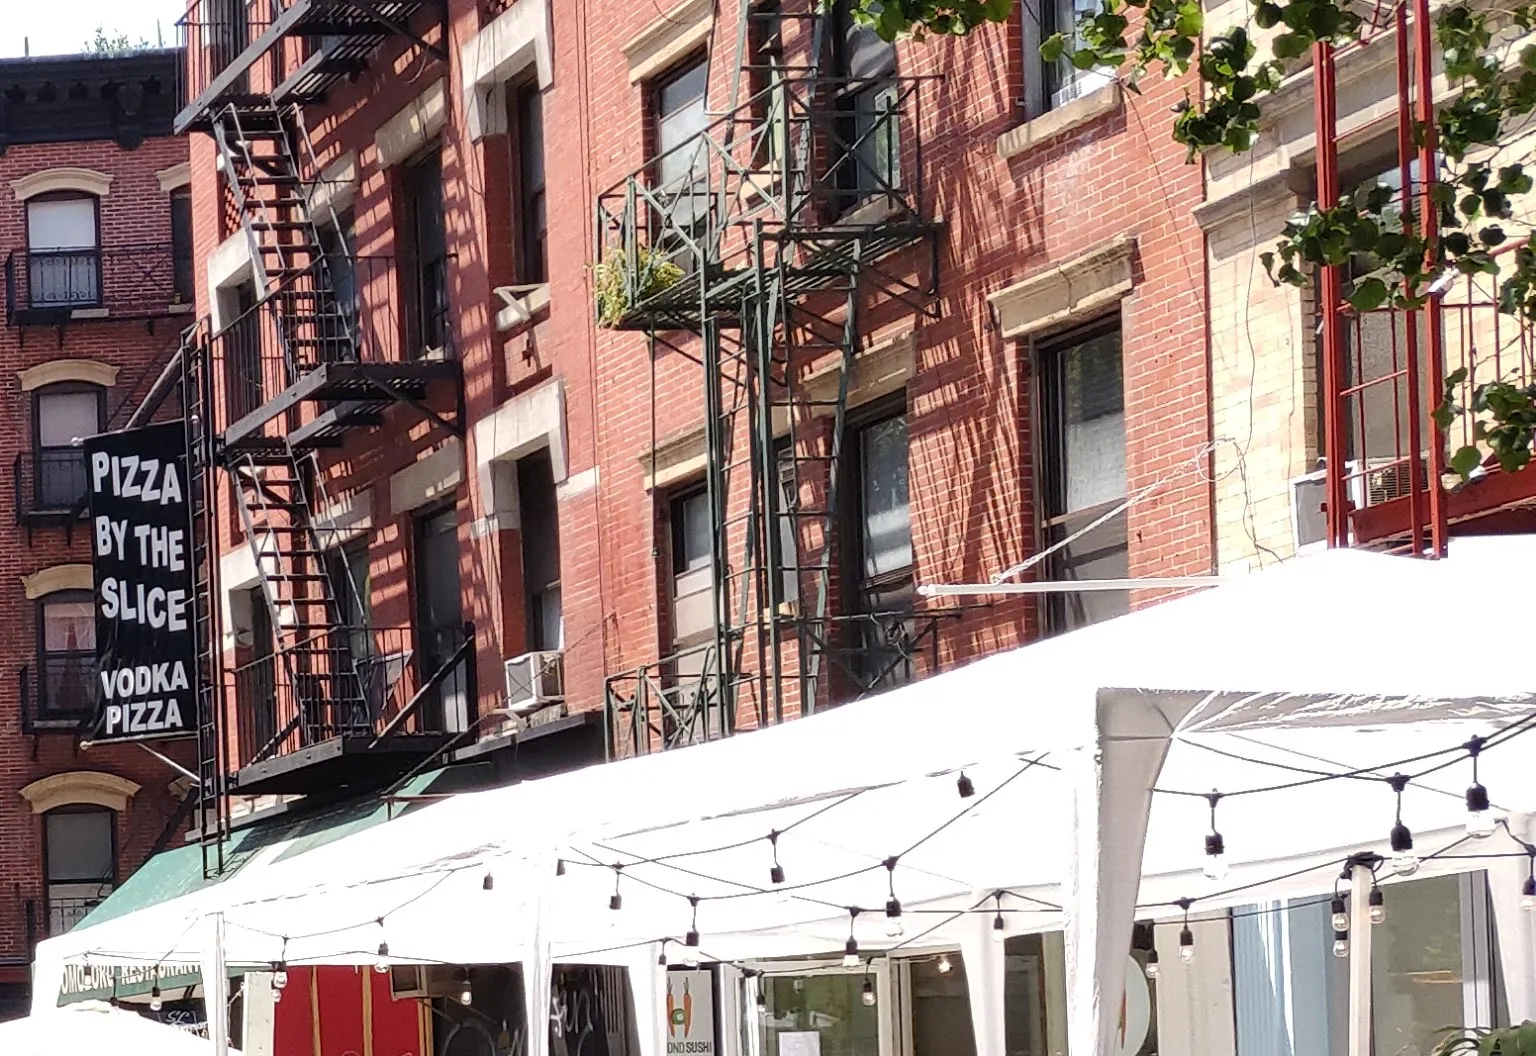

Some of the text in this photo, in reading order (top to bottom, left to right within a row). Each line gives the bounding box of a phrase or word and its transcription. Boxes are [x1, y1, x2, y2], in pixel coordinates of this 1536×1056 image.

[92, 451, 182, 505] PIZZA
[95, 515, 185, 572] BY THE
[101, 577, 187, 632] SLICE
[101, 661, 189, 699] VODKA
[106, 698, 183, 734] PIZZA
[686, 1041, 712, 1054] SUSHI
